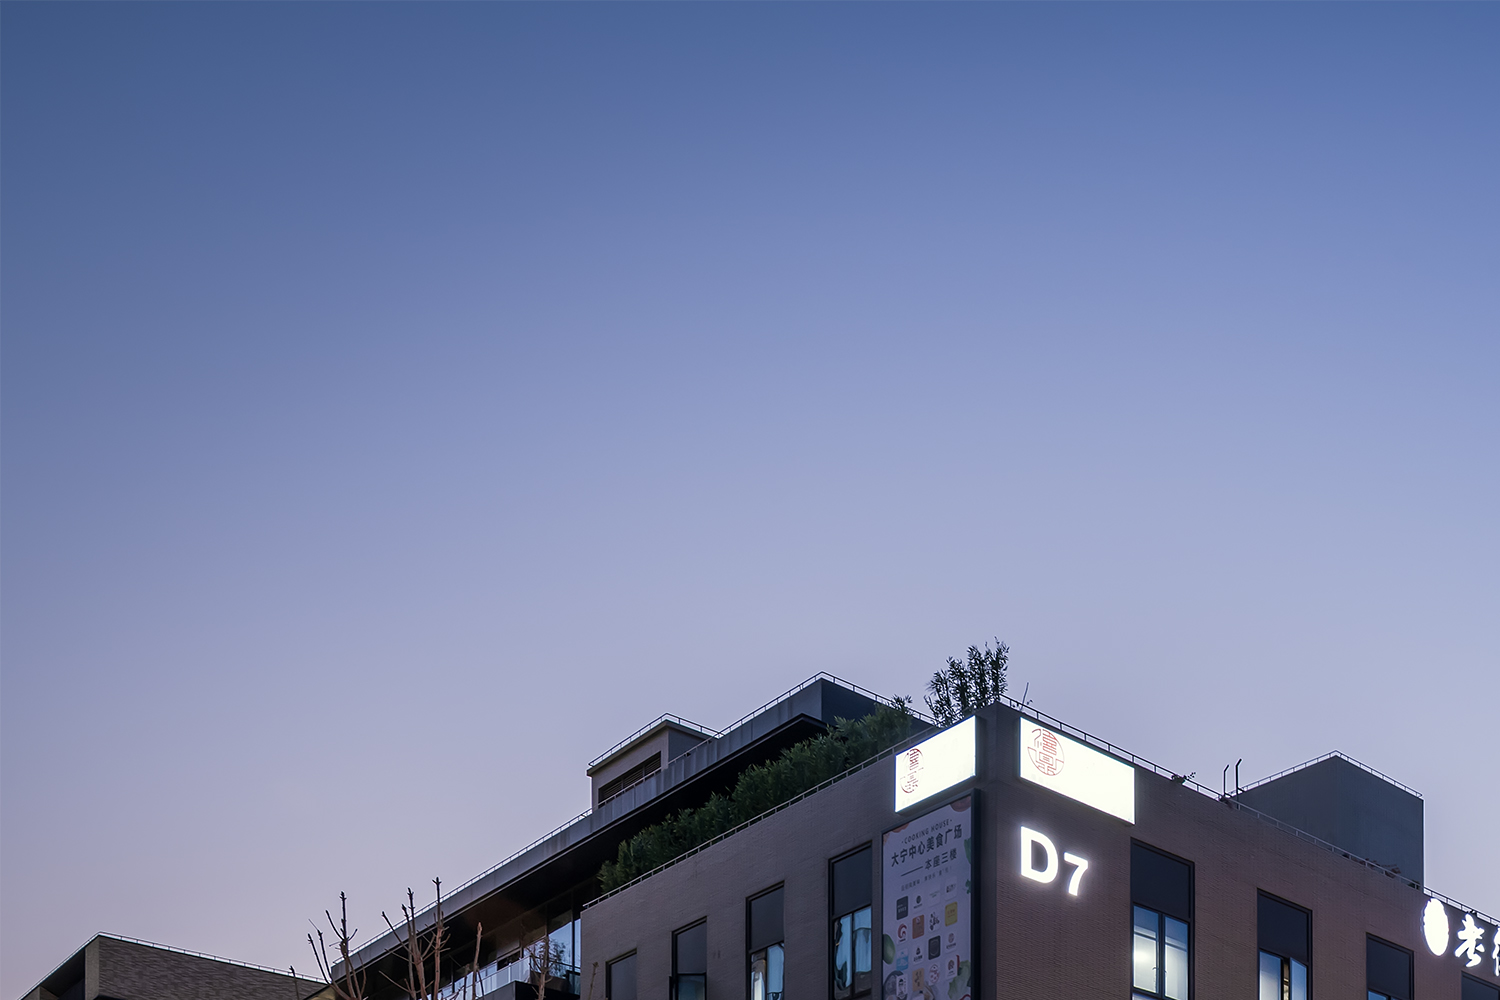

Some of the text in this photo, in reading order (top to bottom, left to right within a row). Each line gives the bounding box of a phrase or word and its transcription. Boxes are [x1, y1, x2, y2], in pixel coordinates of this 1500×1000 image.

[891, 824, 962, 867] 大宁中心美食广场
[1020, 825, 1089, 897] D7
